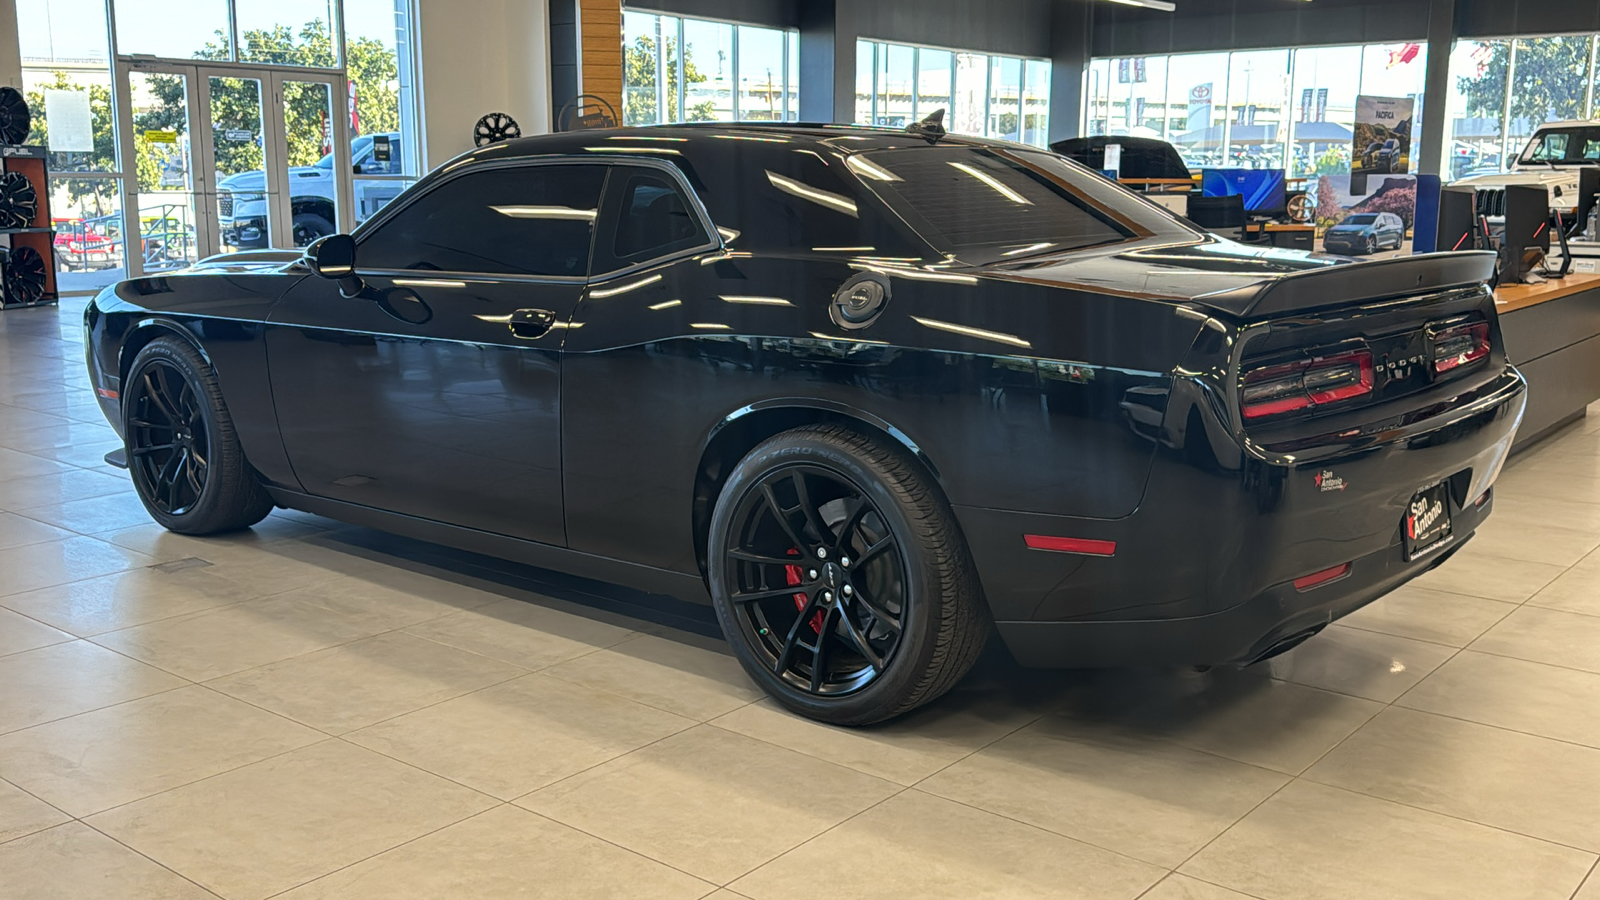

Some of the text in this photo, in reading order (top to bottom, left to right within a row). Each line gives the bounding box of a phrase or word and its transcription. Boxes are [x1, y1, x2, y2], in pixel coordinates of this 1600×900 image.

[1376, 110, 1395, 119] PACIFICA
[771, 447, 813, 459] ZERO
[1322, 470, 1333, 479] San
[1321, 476, 1343, 487] Antonio
[1411, 497, 1428, 521] San
[1413, 500, 1443, 540] Antonio
